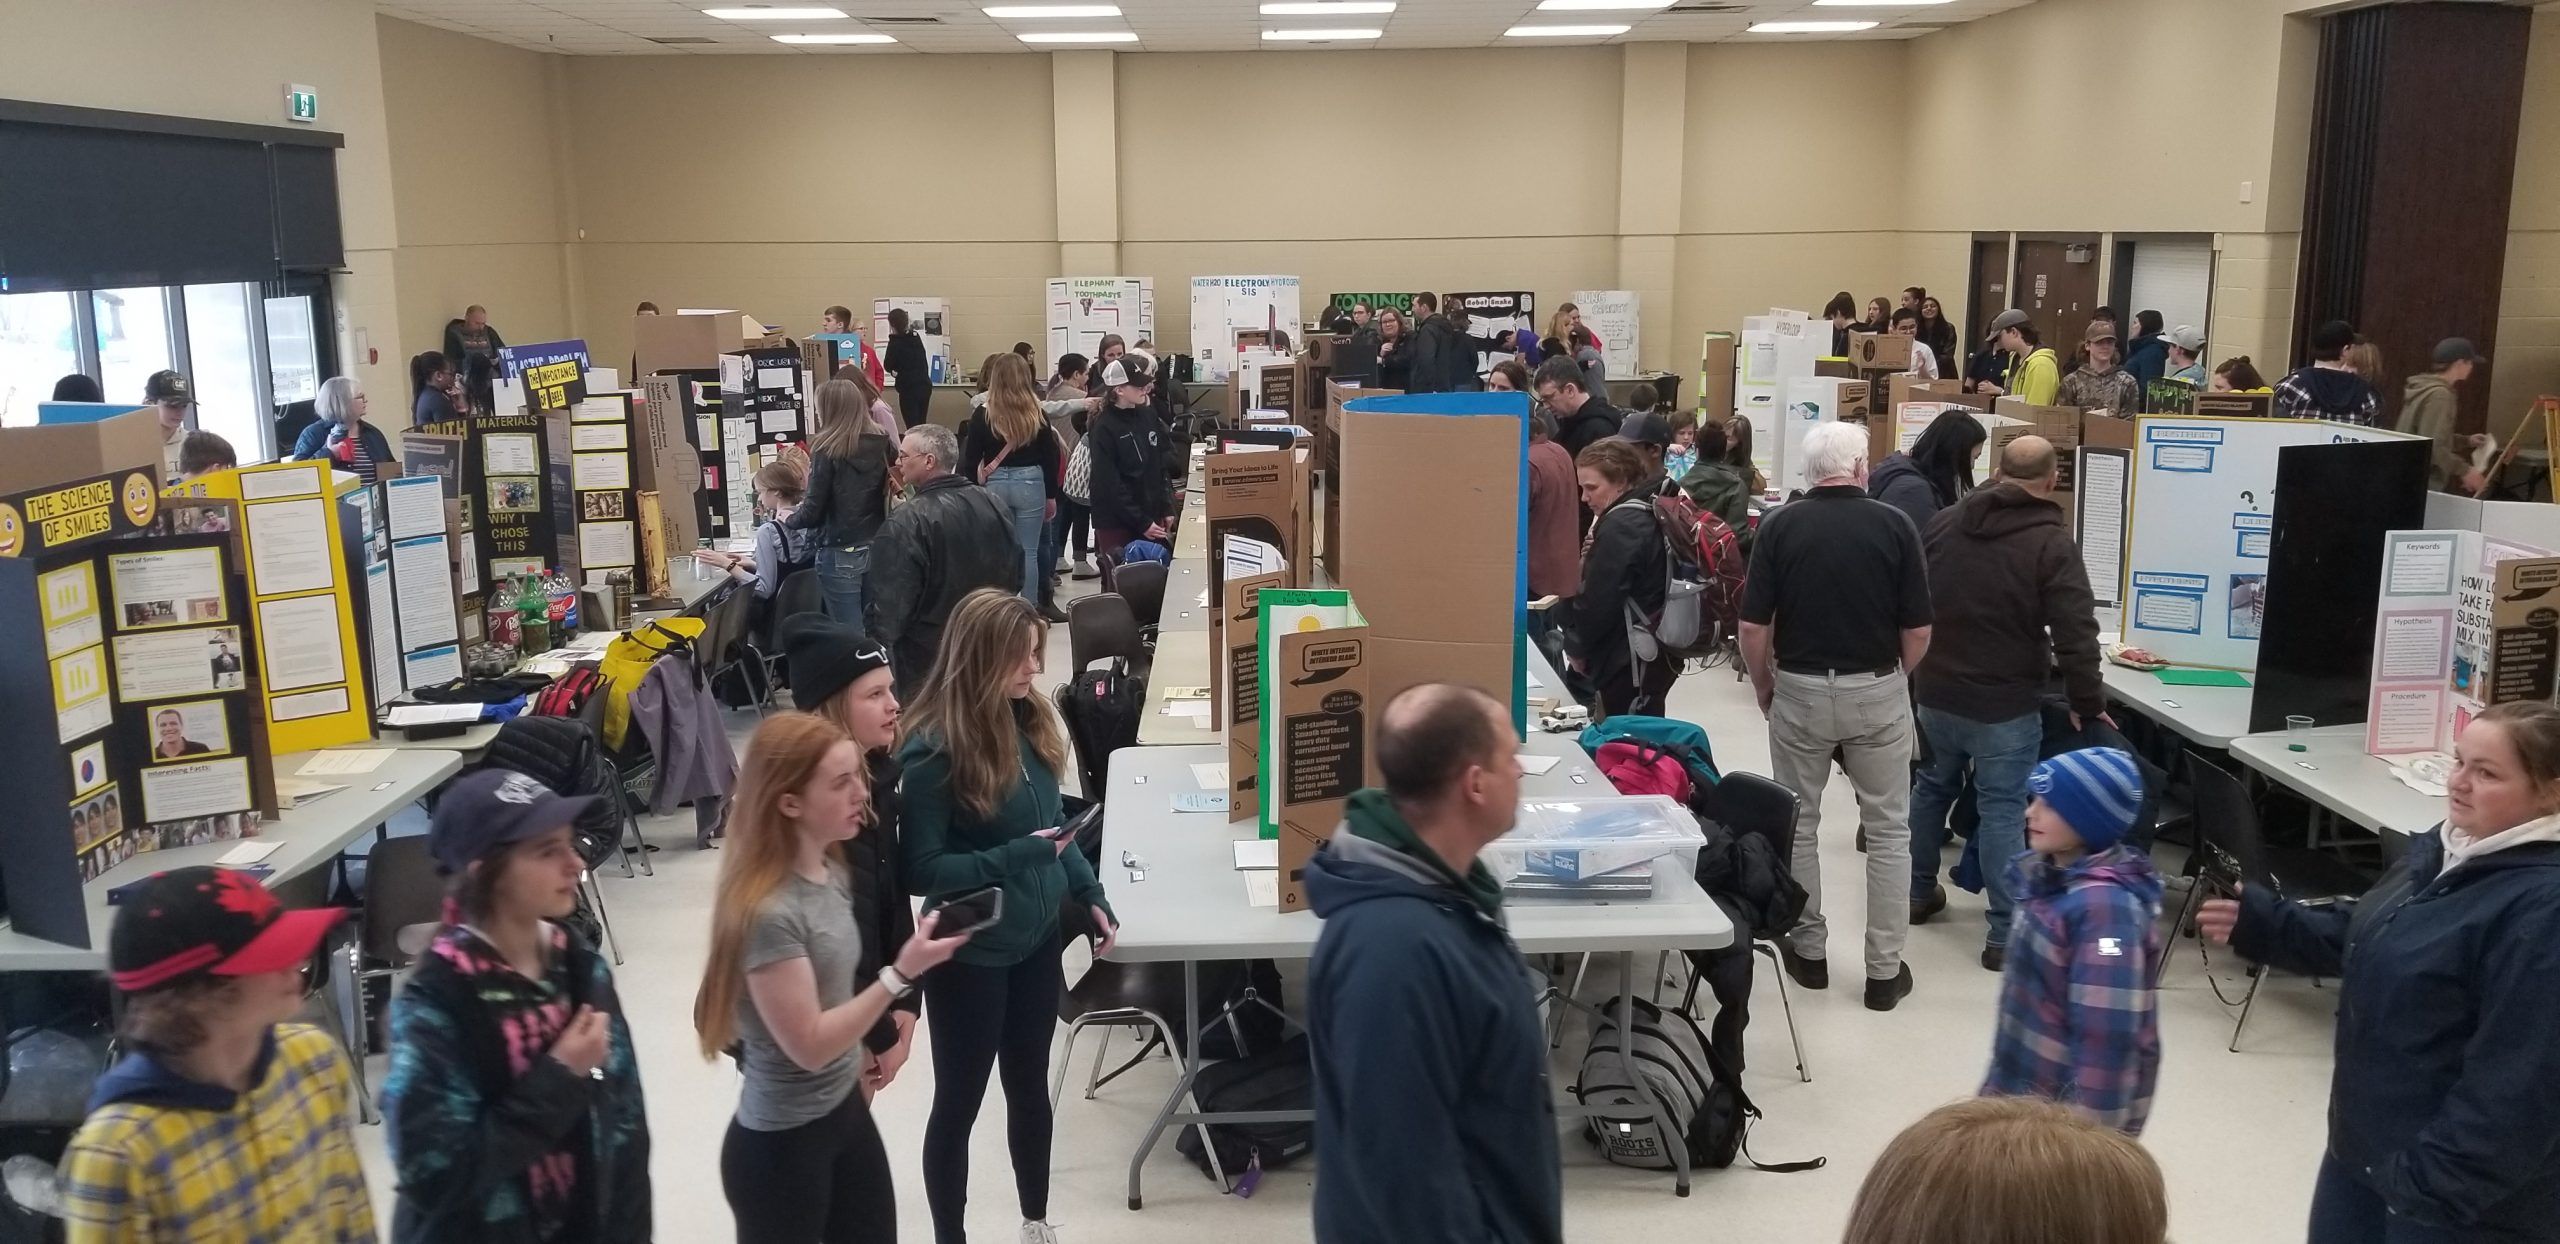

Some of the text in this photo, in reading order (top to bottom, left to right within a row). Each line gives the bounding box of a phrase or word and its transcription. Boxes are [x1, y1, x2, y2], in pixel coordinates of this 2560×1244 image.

[1225, 279, 1270, 287] ELECTROLY
[1075, 291, 1121, 299] TOOTHPASTE
[1241, 288, 1256, 296] SIS
[1577, 292, 1606, 304] LUNG
[1335, 294, 1410, 311] CODING
[498, 348, 514, 360] THE
[540, 365, 576, 383] IMPORTANCE
[476, 415, 538, 429] MATERIALS
[1211, 467, 1228, 475] Bring
[28, 482, 112, 519] THE SCIENCE
[488, 514, 518, 524] WHY
[44, 511, 110, 543] OF SMILES
[491, 527, 530, 539] CHOSE
[496, 541, 526, 552] THIS
[2461, 575, 2483, 590] HOW
[2459, 592, 2481, 610] TAKE
[2457, 610, 2492, 631] SUBSTA
[2456, 626, 2475, 643] MIX
[1328, 646, 1355, 655] INTERIOR
[1295, 720, 1338, 730] Self-standing
[1295, 726, 1349, 738] Smooth surfaced
[1295, 739, 1314, 747] Heavy
[1295, 742, 1350, 755] corrugated board
[1295, 755, 1341, 766] Aucun support
[147, 767, 188, 778] Interesting
[1295, 774, 1319, 783] Surface
[1295, 783, 1316, 791] Carton
[1608, 1134, 1656, 1149] ROOTS
